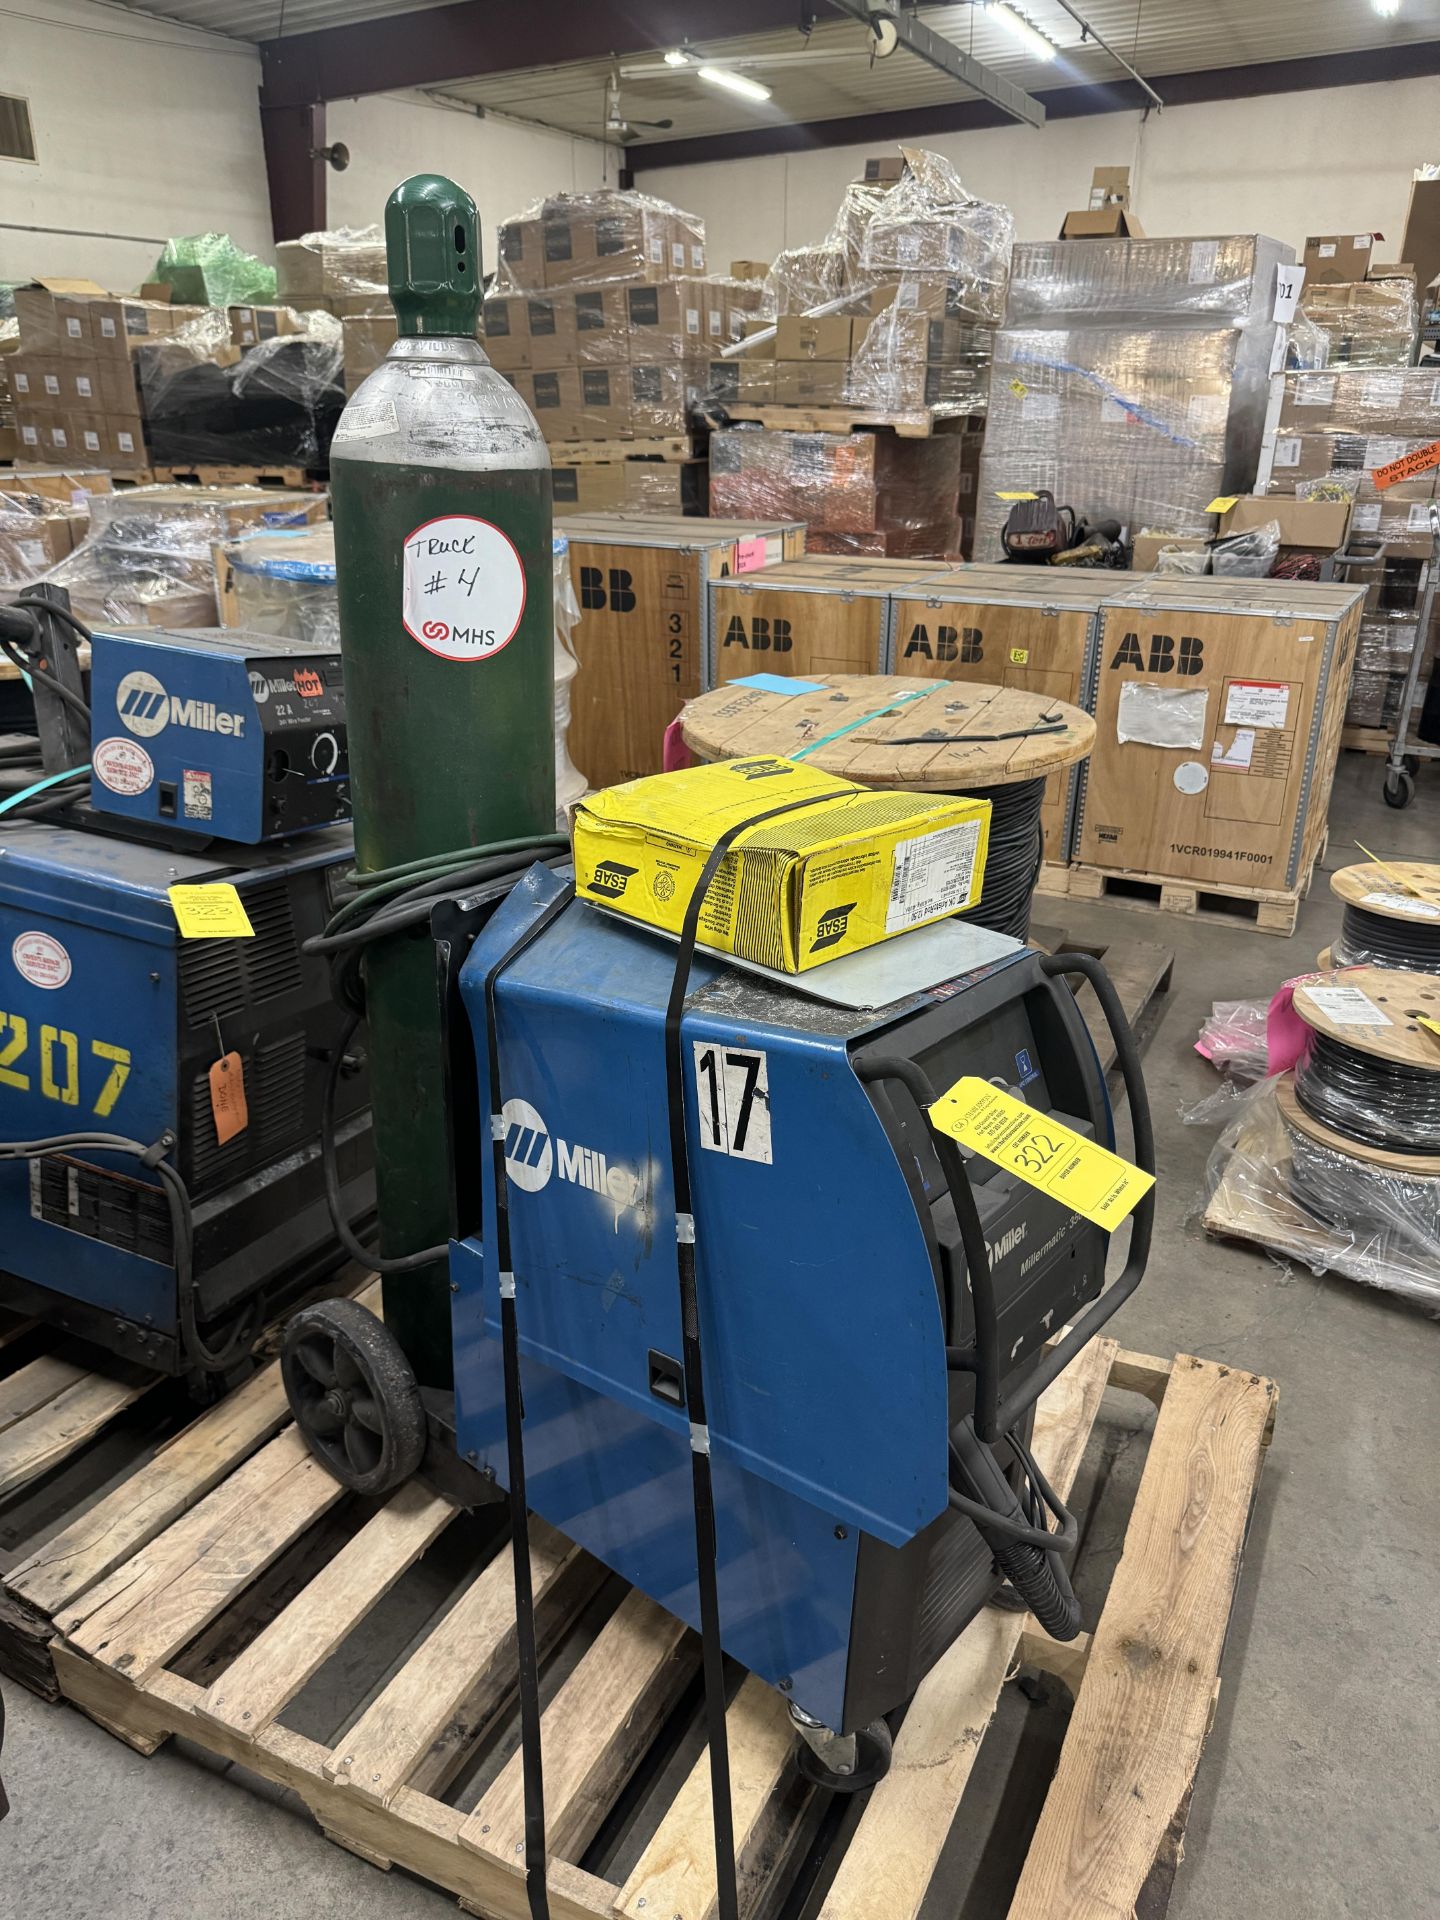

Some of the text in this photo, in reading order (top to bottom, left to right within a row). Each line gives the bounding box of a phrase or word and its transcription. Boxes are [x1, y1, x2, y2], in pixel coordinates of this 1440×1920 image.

[1376, 445, 1438, 478] DO NOT DOUBLE
[1389, 457, 1436, 482] STACK
[407, 536, 475, 558] TRUCK
[458, 567, 480, 596] 4
[580, 567, 636, 612] BB
[452, 626, 494, 646] MHS
[669, 614, 682, 634] 3
[724, 616, 793, 652] ABB
[670, 639, 682, 659] 2
[903, 624, 984, 664] ABB
[1110, 632, 1204, 676] ABB
[298, 680, 320, 692] HOT
[671, 664, 680, 682] 1
[171, 697, 244, 738] Miller
[276, 705, 286, 716] 22
[1170, 843, 1272, 865] 1VCR019941F0001
[594, 870, 628, 890] ESAB
[185, 908, 232, 916] 323
[817, 916, 848, 938] ESAB
[0, 1010, 130, 1118] 207
[700, 1050, 761, 1152] 17
[1014, 1134, 1064, 1174] 322
[556, 1138, 640, 1206] Miller
[994, 1221, 1026, 1264] Miller
[1020, 1226, 1066, 1278] Millermatic
